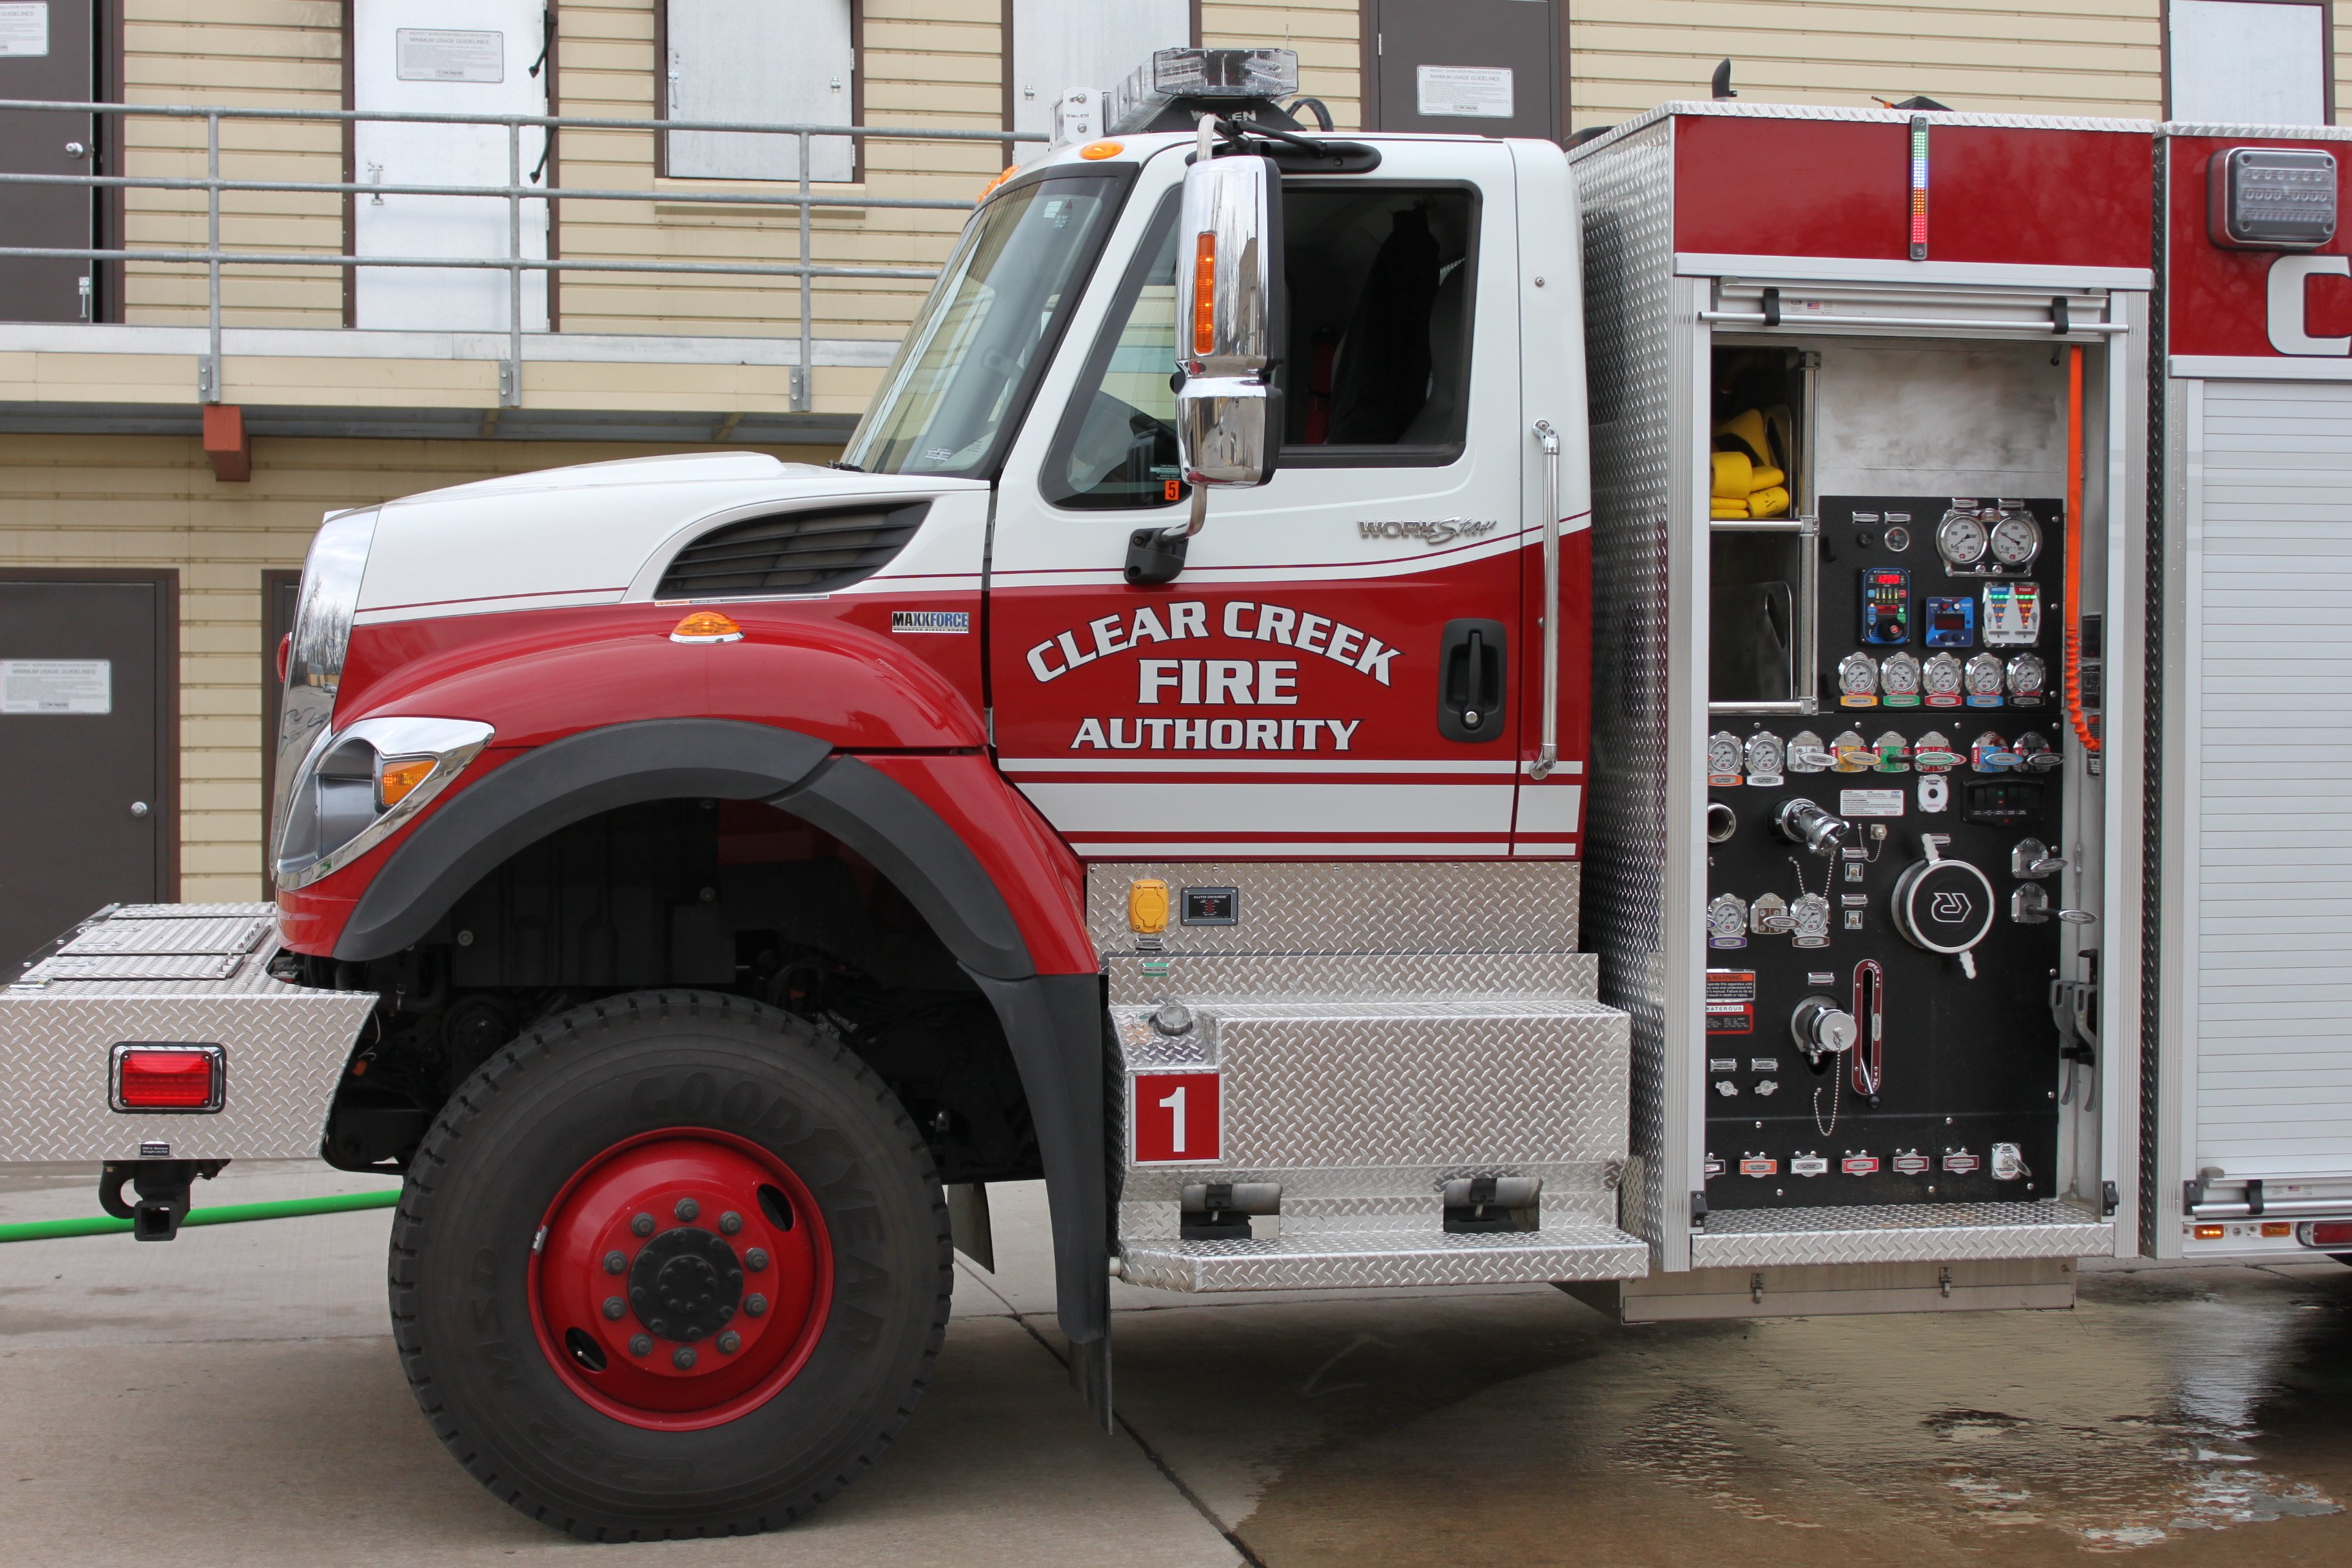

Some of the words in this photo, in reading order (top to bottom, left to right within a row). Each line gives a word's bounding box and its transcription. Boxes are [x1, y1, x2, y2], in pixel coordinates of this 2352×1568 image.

[1168, 482, 1176, 498] 5
[892, 612, 968, 627] MAXXFORCE
[1026, 600, 1209, 683] CLEAR
[1223, 600, 1405, 687] CREEK
[1137, 659, 1298, 705] FIRE
[1069, 717, 1365, 751] AUTHORITY
[1867, 962, 1880, 975] OPEN
[1158, 1087, 1186, 1152] 1
[629, 1071, 890, 1356] GOODYEAR
